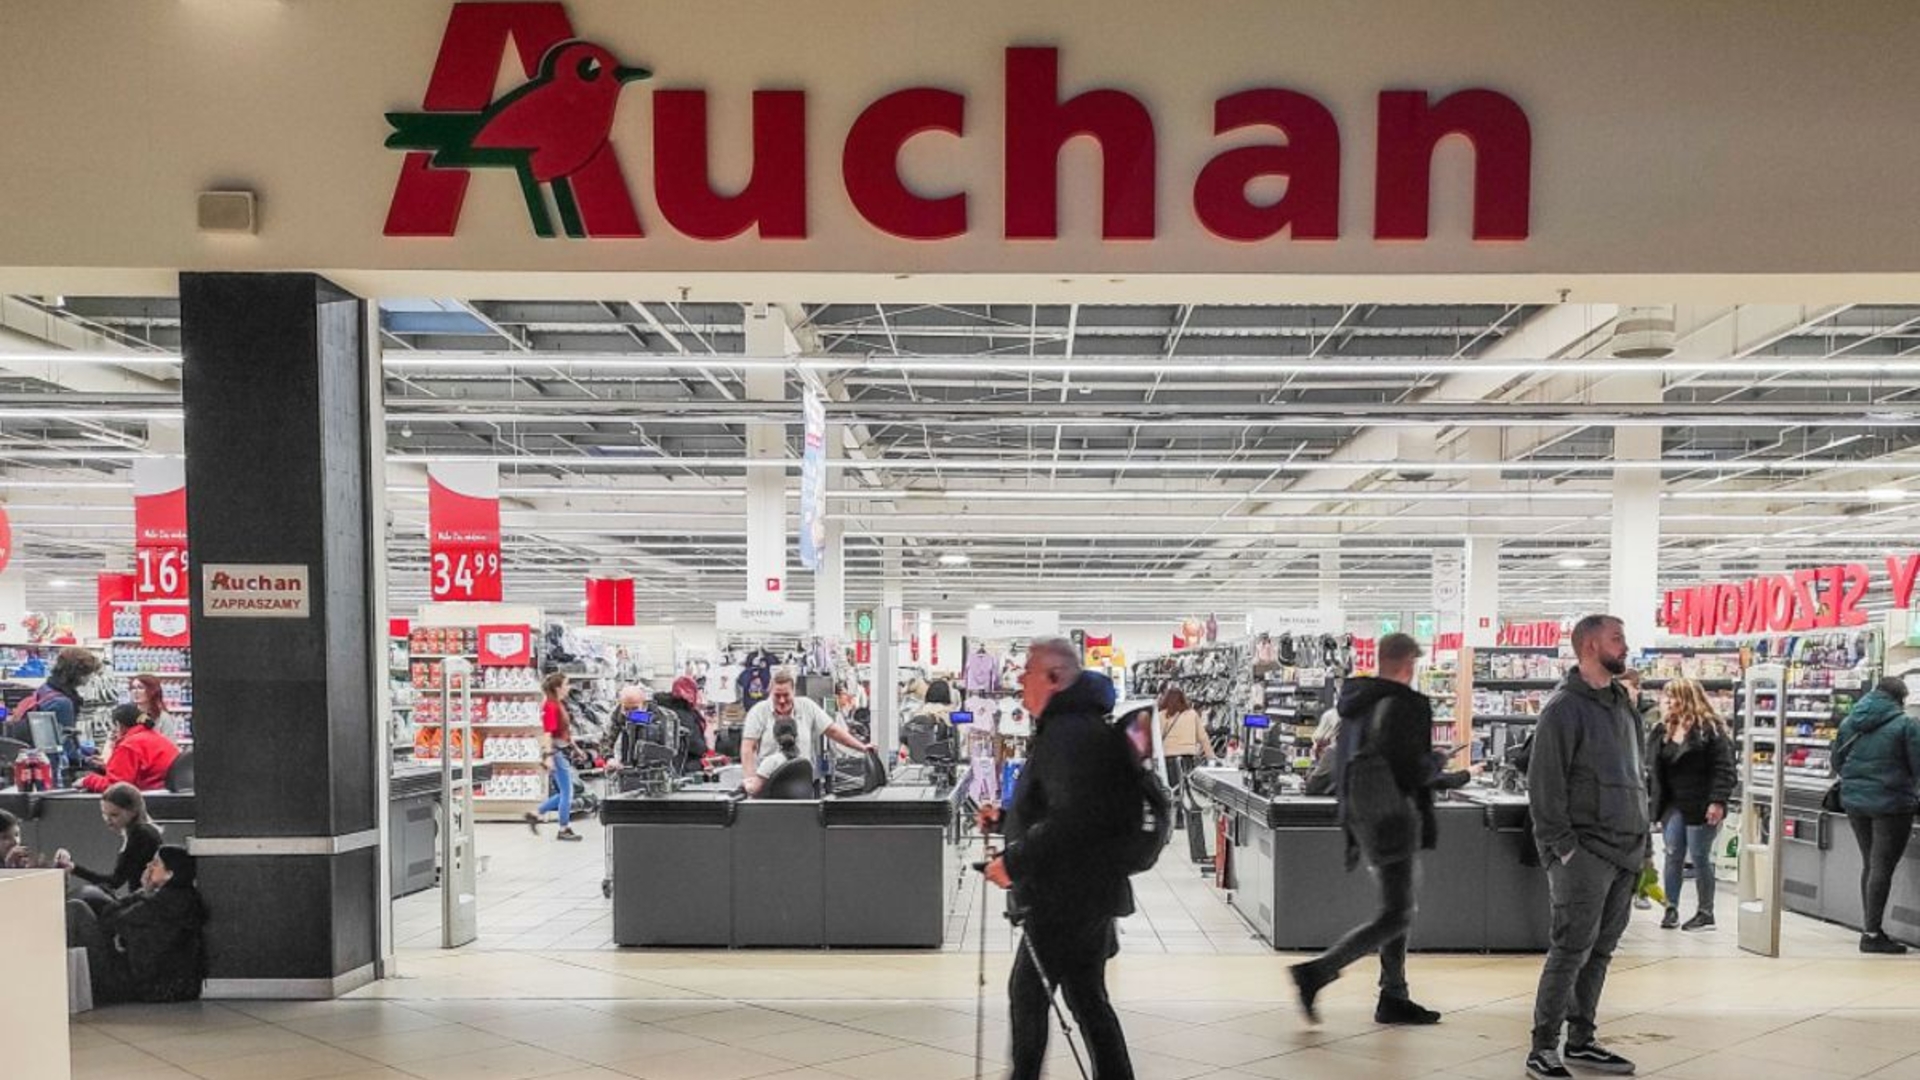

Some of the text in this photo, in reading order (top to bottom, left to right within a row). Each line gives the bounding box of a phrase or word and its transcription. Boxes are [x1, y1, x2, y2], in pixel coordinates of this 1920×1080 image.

[384, 1, 1532, 240] Auchan
[210, 571, 302, 591] Auchan
[211, 598, 302, 610] ZAPRASZAMY
